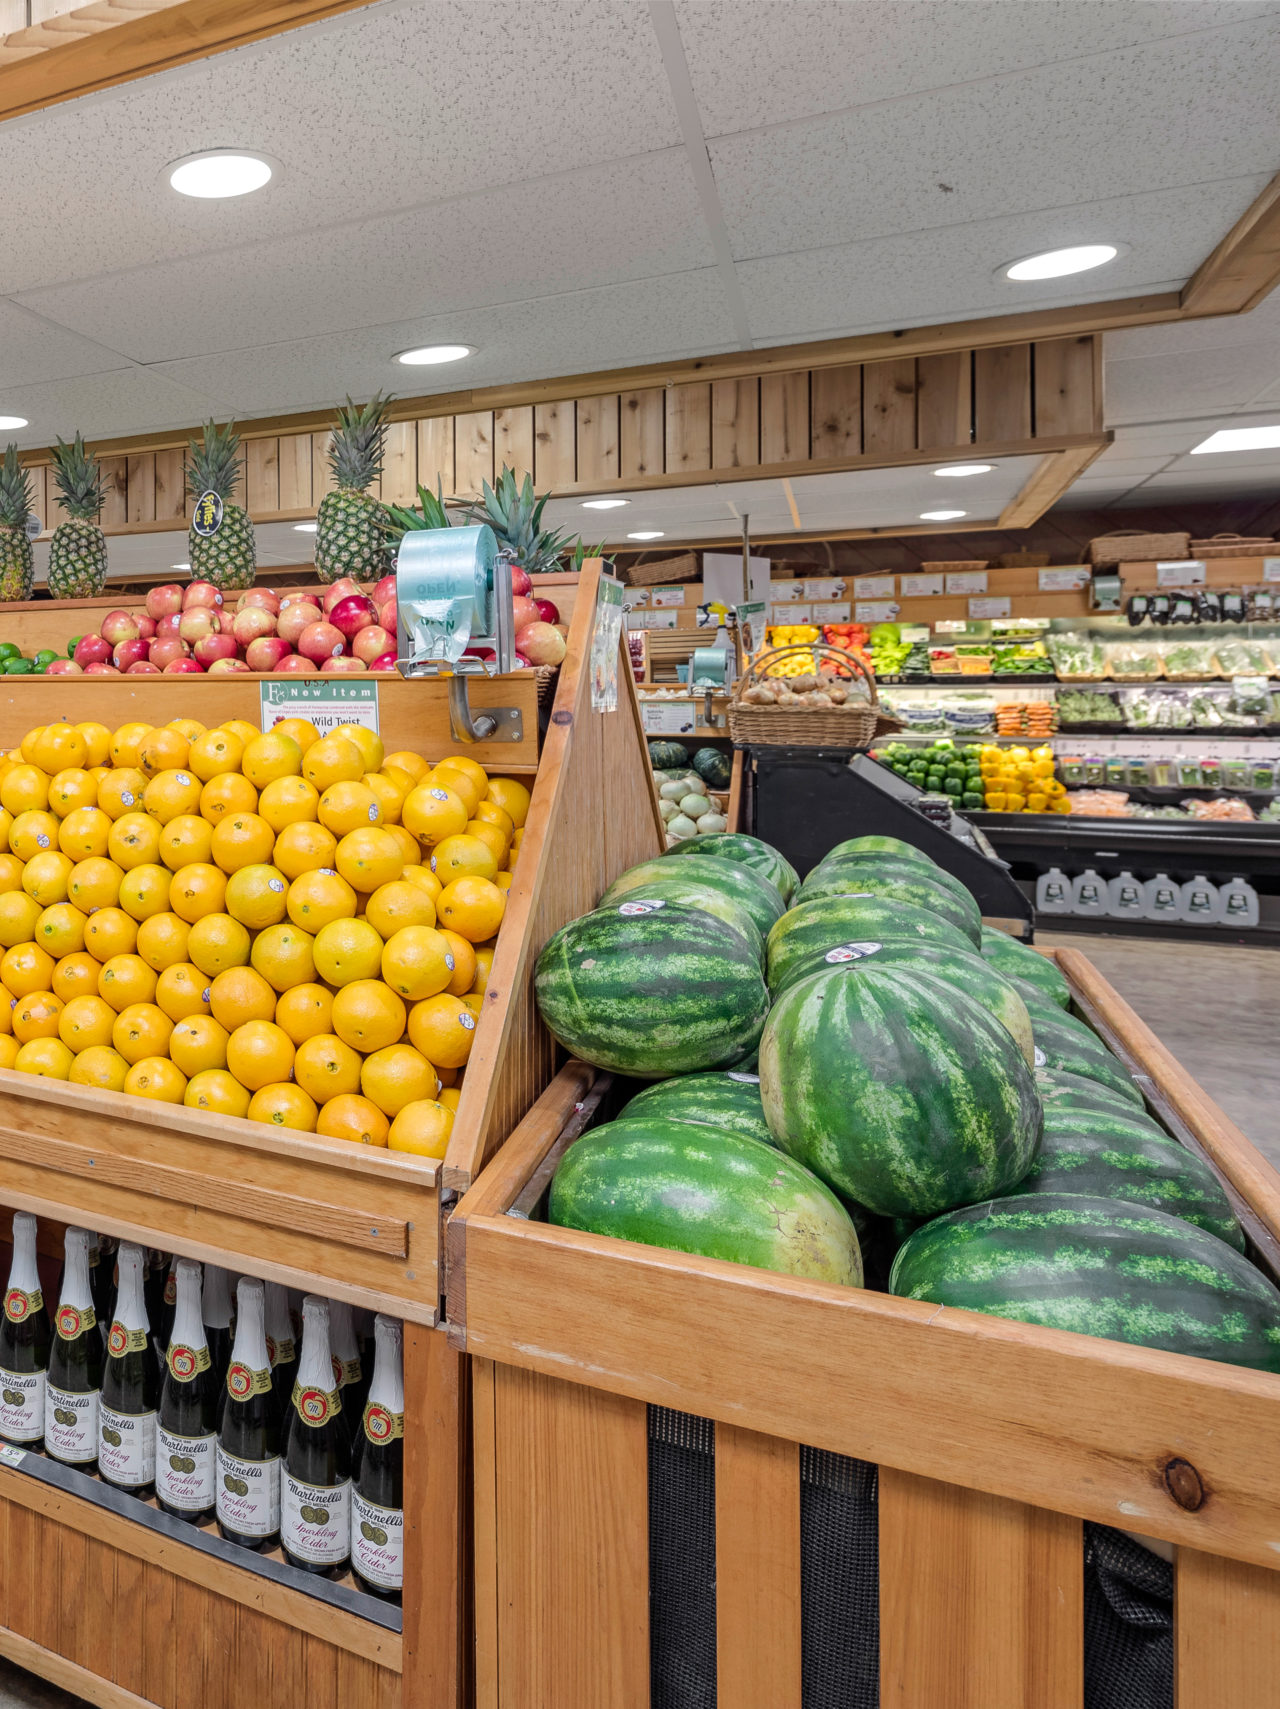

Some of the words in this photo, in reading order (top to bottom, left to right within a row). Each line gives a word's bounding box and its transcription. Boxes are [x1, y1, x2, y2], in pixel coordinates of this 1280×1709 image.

[291, 688, 321, 697] New
[332, 688, 371, 697] Item
[311, 716, 333, 727] Wild
[336, 716, 360, 727] Twist
[0, 1403, 34, 1420] Sparkling
[1, 1413, 24, 1427] Cider
[49, 1423, 86, 1441] Sparkling
[53, 1433, 76, 1448] Cider
[100, 1441, 131, 1462] Sparkling
[101, 1454, 121, 1469] Cider
[165, 1470, 204, 1487] Sparkling
[168, 1482, 195, 1496] Cider
[220, 1490, 258, 1514] Sparkling
[222, 1500, 247, 1520] Cider
[292, 1520, 339, 1540] Sparkling
[299, 1533, 329, 1549] Cider
[356, 1538, 399, 1564] Sparkling
[359, 1549, 387, 1571] Cider
